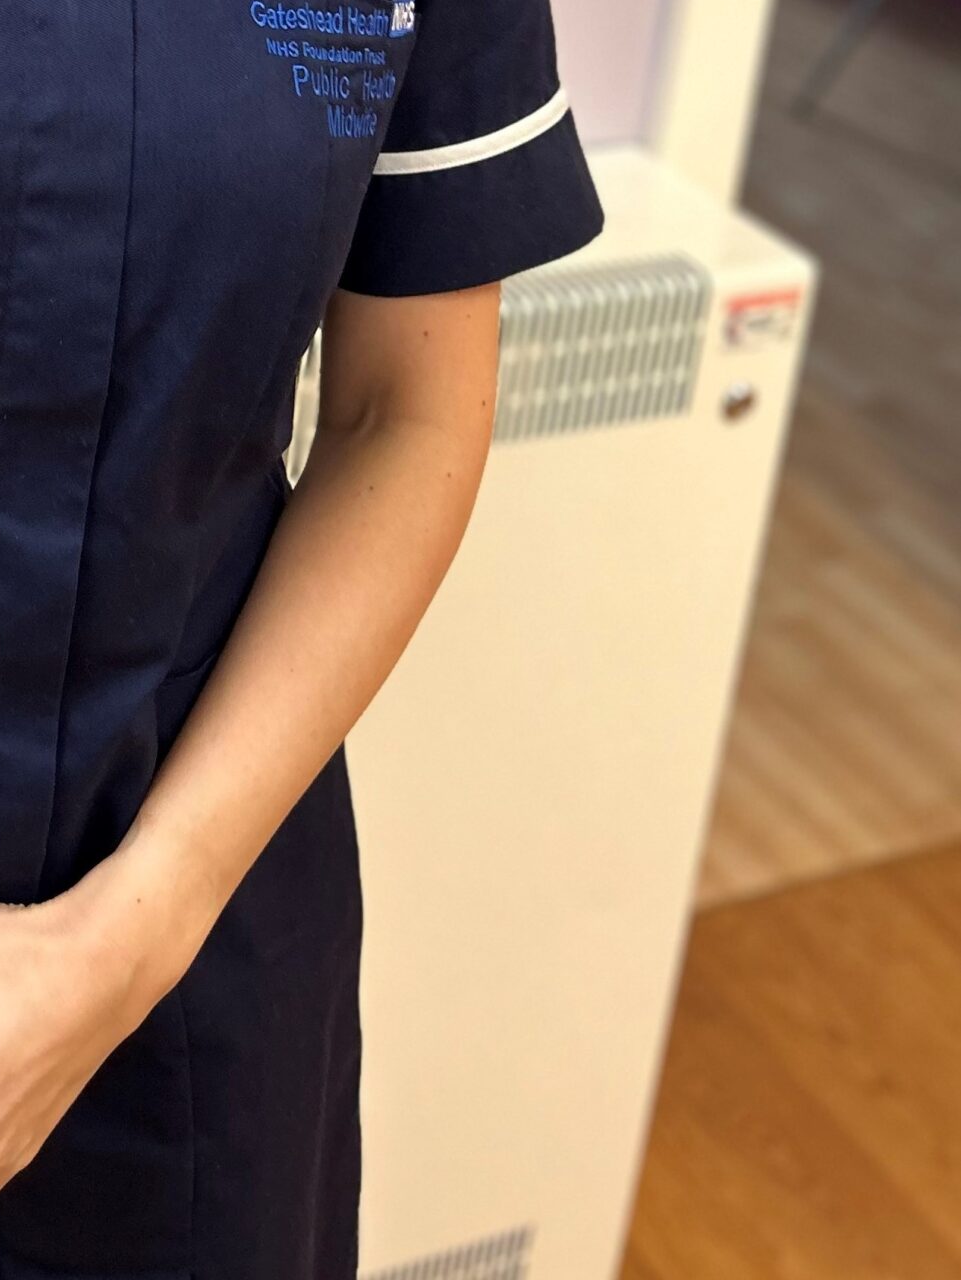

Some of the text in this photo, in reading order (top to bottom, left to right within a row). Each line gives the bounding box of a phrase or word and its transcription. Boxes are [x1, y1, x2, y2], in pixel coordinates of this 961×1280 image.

[250, 0, 416, 38] Gateshead Health NHS
[266, 37, 386, 66] NHS Foundation Trust
[292, 65, 350, 99] Public
